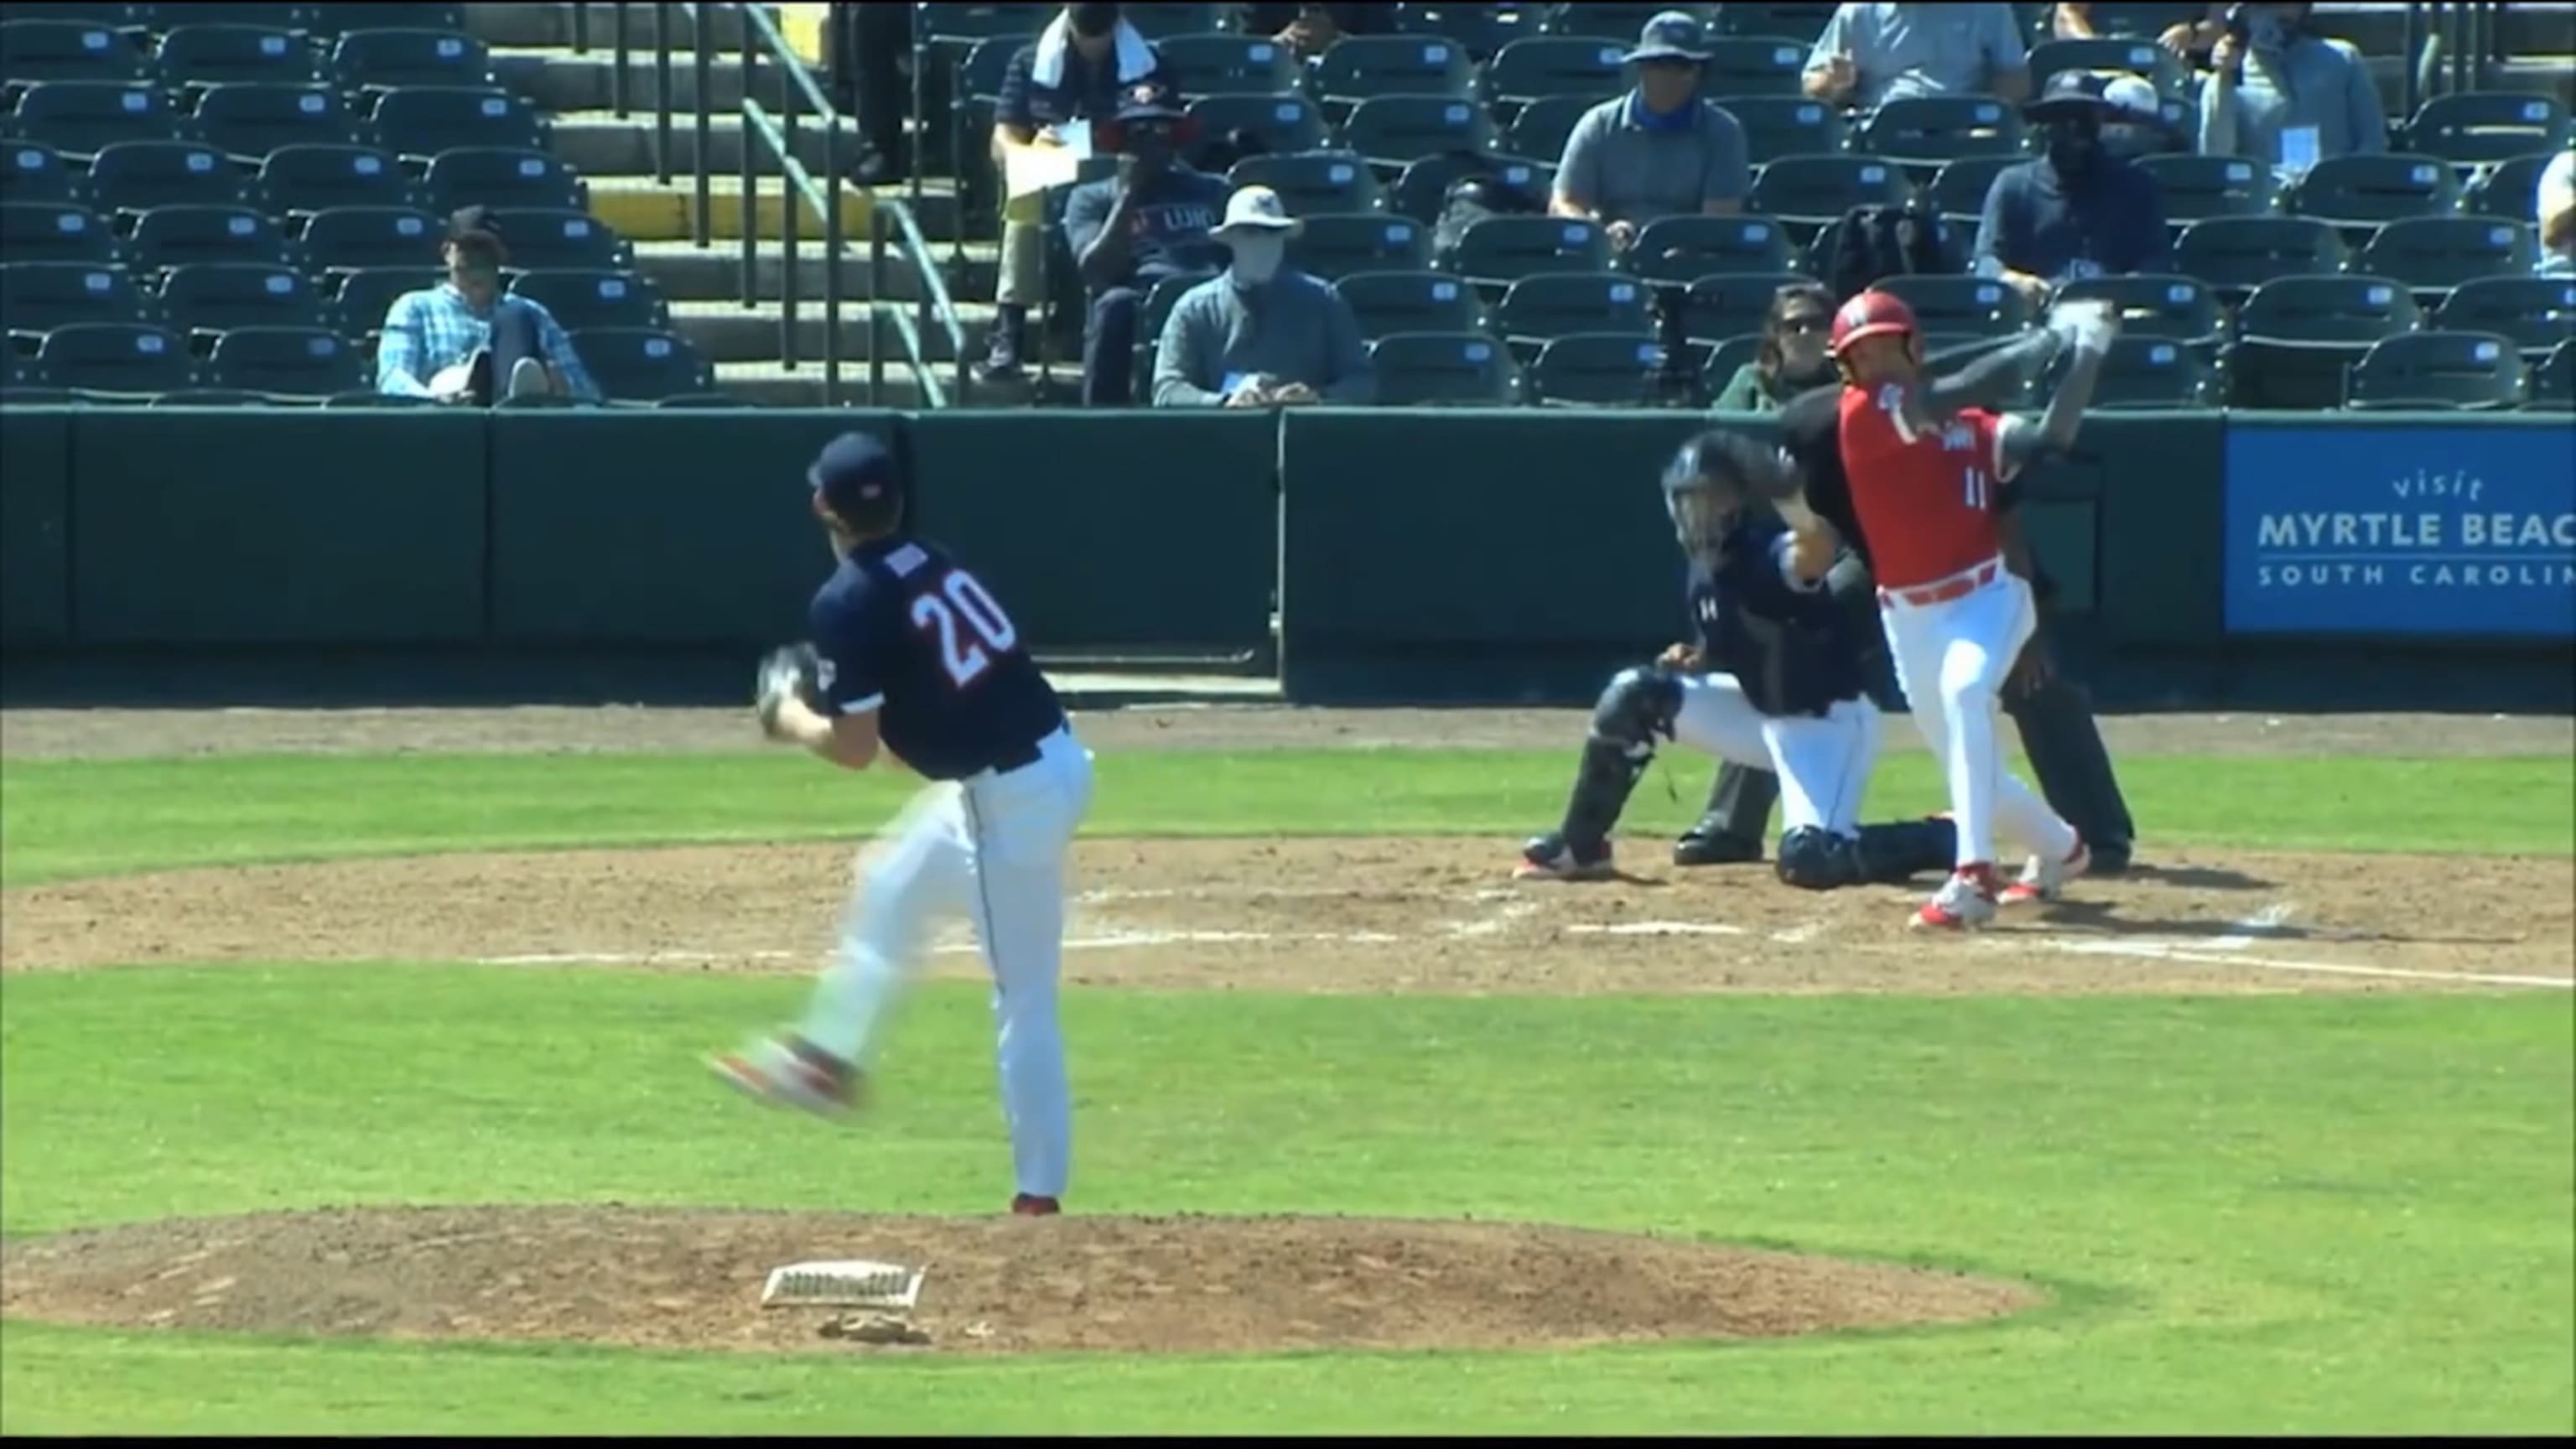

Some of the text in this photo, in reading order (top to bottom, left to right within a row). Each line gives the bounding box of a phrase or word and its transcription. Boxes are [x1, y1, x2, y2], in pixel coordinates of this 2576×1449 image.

[1965, 466, 1986, 509] 11
[2393, 470, 2483, 501] visit
[2259, 513, 2442, 547] MYRTLE
[2259, 564, 2384, 586] SOUTH
[912, 569, 1016, 688] 20
